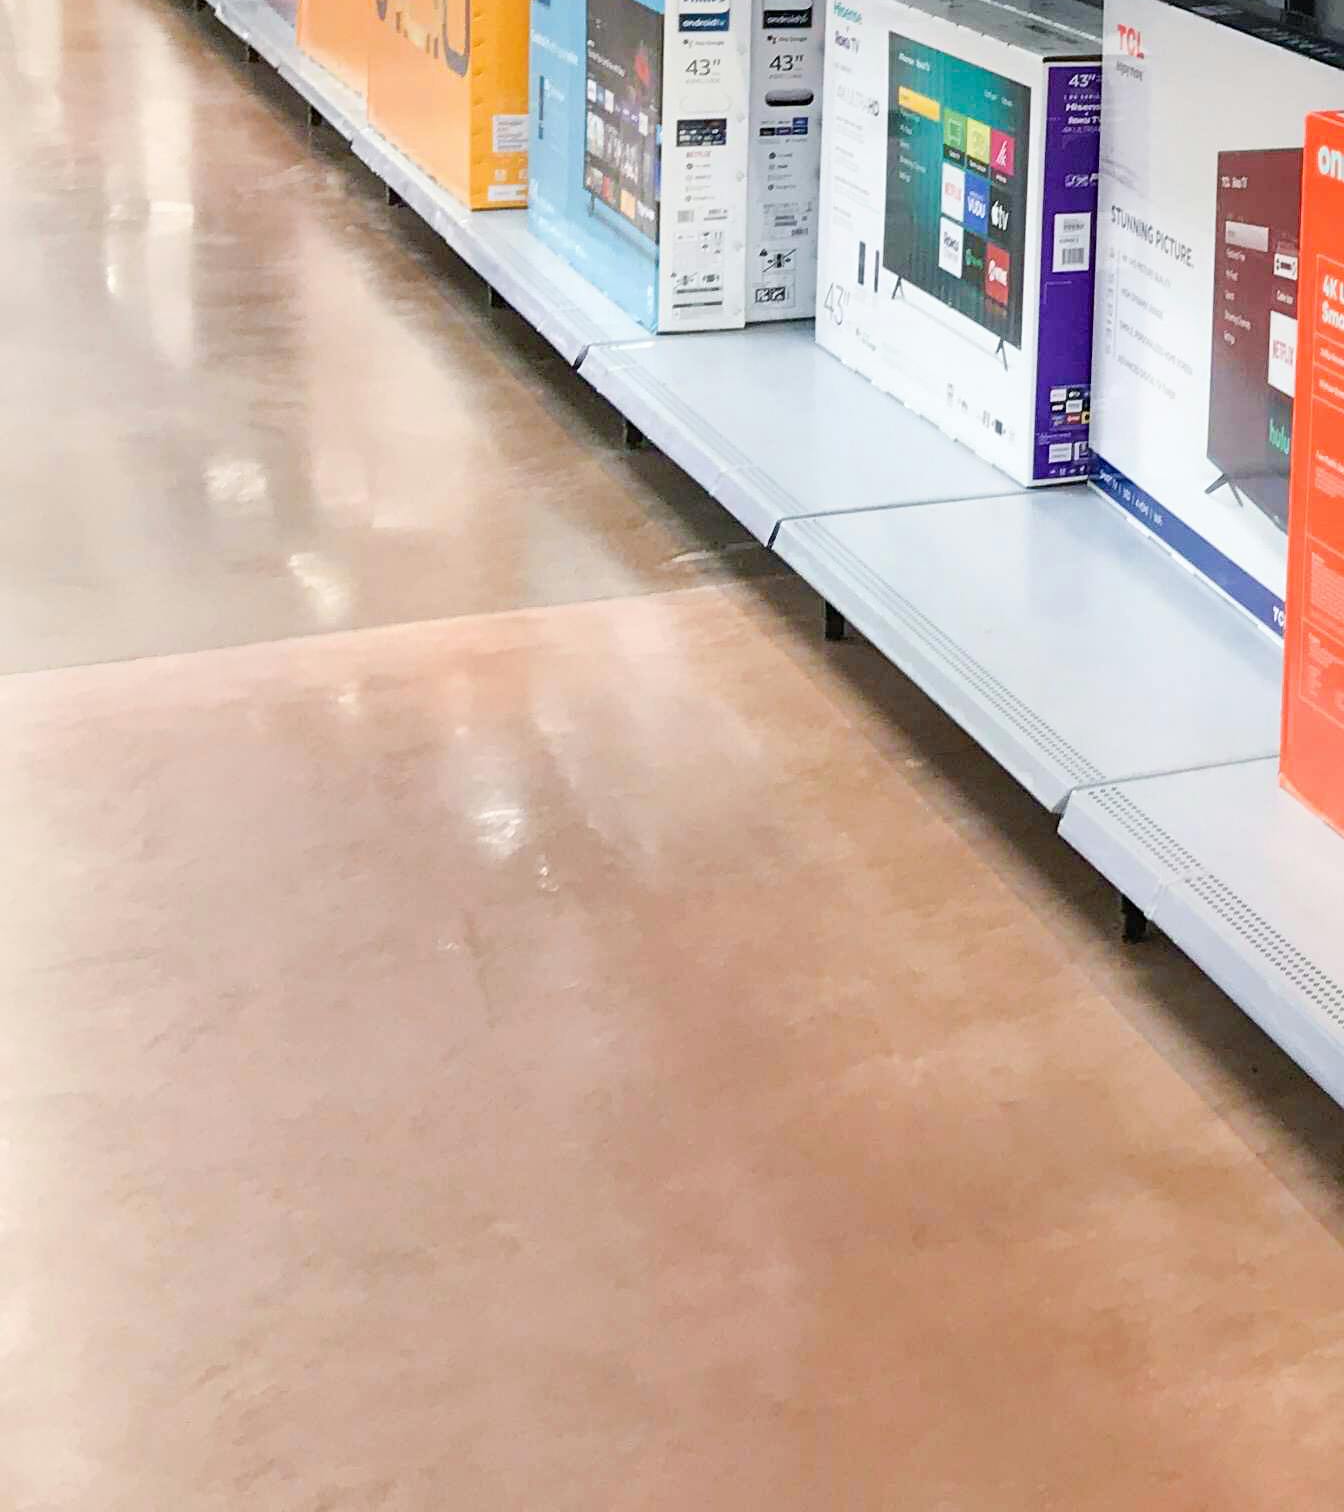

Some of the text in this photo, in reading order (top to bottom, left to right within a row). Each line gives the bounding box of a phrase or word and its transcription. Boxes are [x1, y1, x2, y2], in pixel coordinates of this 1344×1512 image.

[1117, 24, 1145, 59] TCL
[685, 57, 721, 76] 43"
[768, 54, 804, 72] 43"
[1111, 205, 1194, 268] STUNNING PICTURE.
[1323, 274, 1338, 300] 4K
